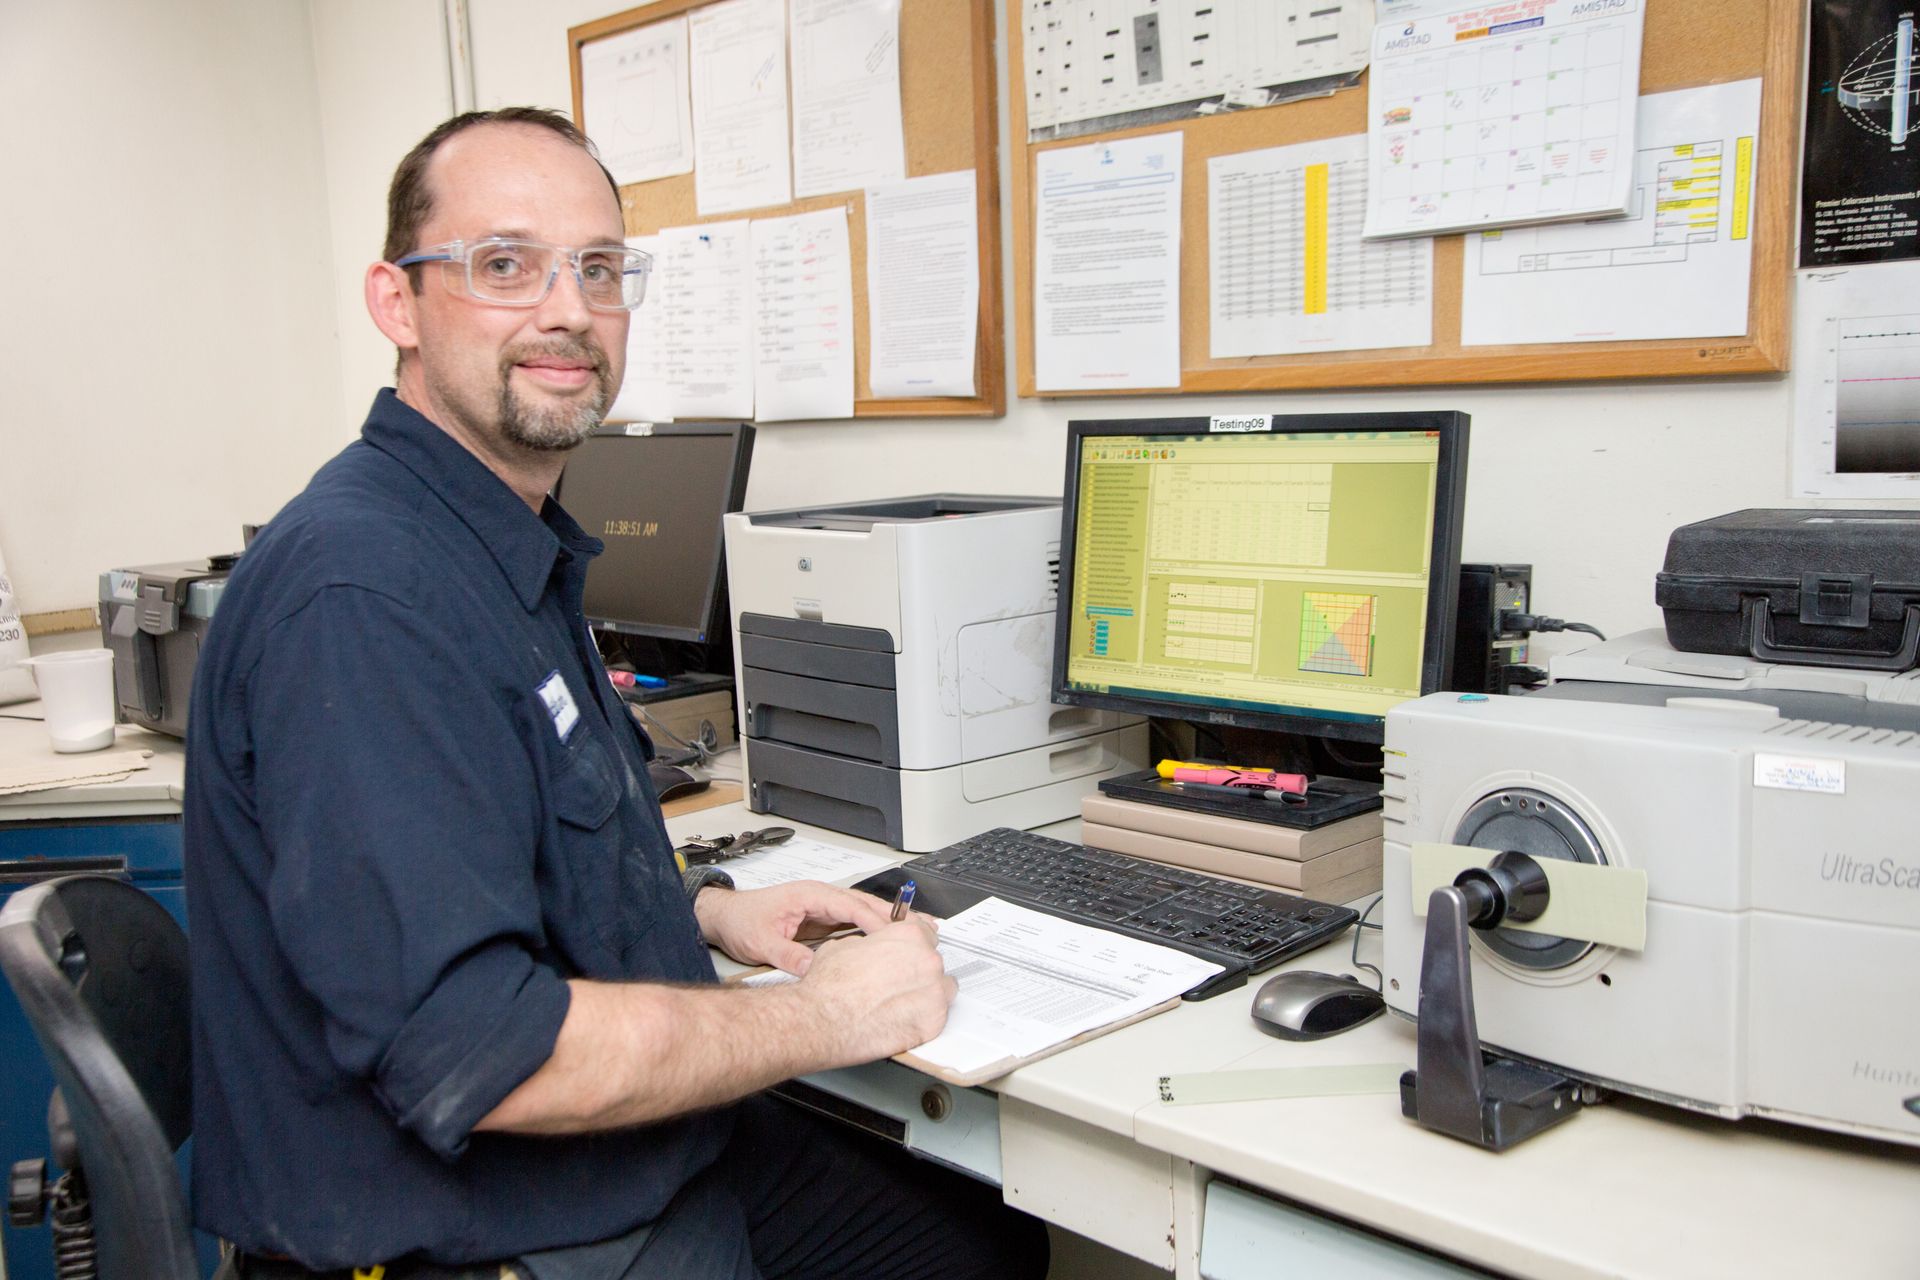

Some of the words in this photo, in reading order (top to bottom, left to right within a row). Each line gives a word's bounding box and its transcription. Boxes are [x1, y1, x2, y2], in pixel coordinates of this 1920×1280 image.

[1384, 32, 1431, 51] AMISTAD
[1815, 200, 1840, 208] Premier
[1875, 191, 1916, 202] Instruments
[1213, 418, 1265, 431] Testing09
[605, 520, 640, 536] 11:38:51
[642, 522, 658, 536] AM
[0, 628, 20, 642] 230
[1820, 851, 1920, 890] UltraSca
